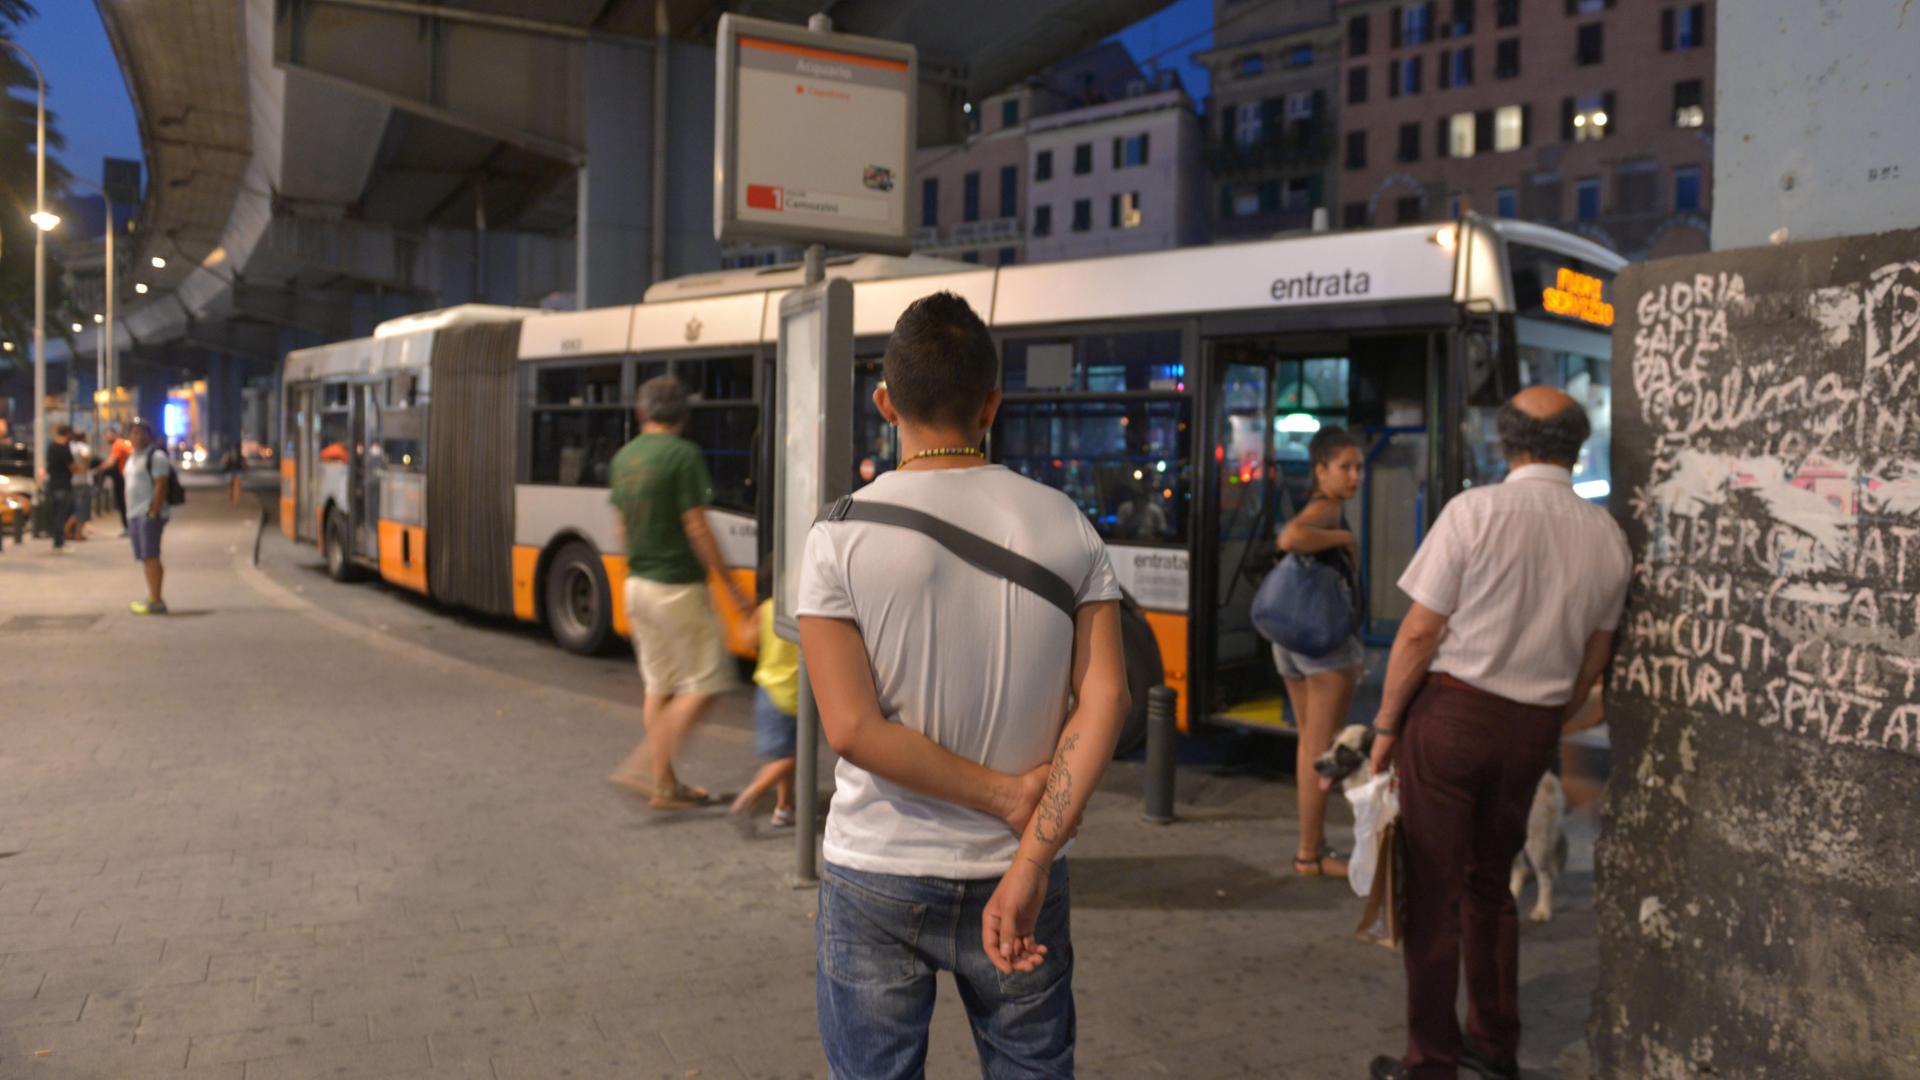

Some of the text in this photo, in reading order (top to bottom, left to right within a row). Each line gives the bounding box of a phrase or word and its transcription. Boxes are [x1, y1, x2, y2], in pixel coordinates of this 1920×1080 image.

[1270, 266, 1370, 301] entrata
[1637, 271, 1746, 326] GLORIA
[1634, 308, 1728, 360] SANTA
[1632, 341, 1720, 401] PACE
[1133, 553, 1189, 571] entrata
